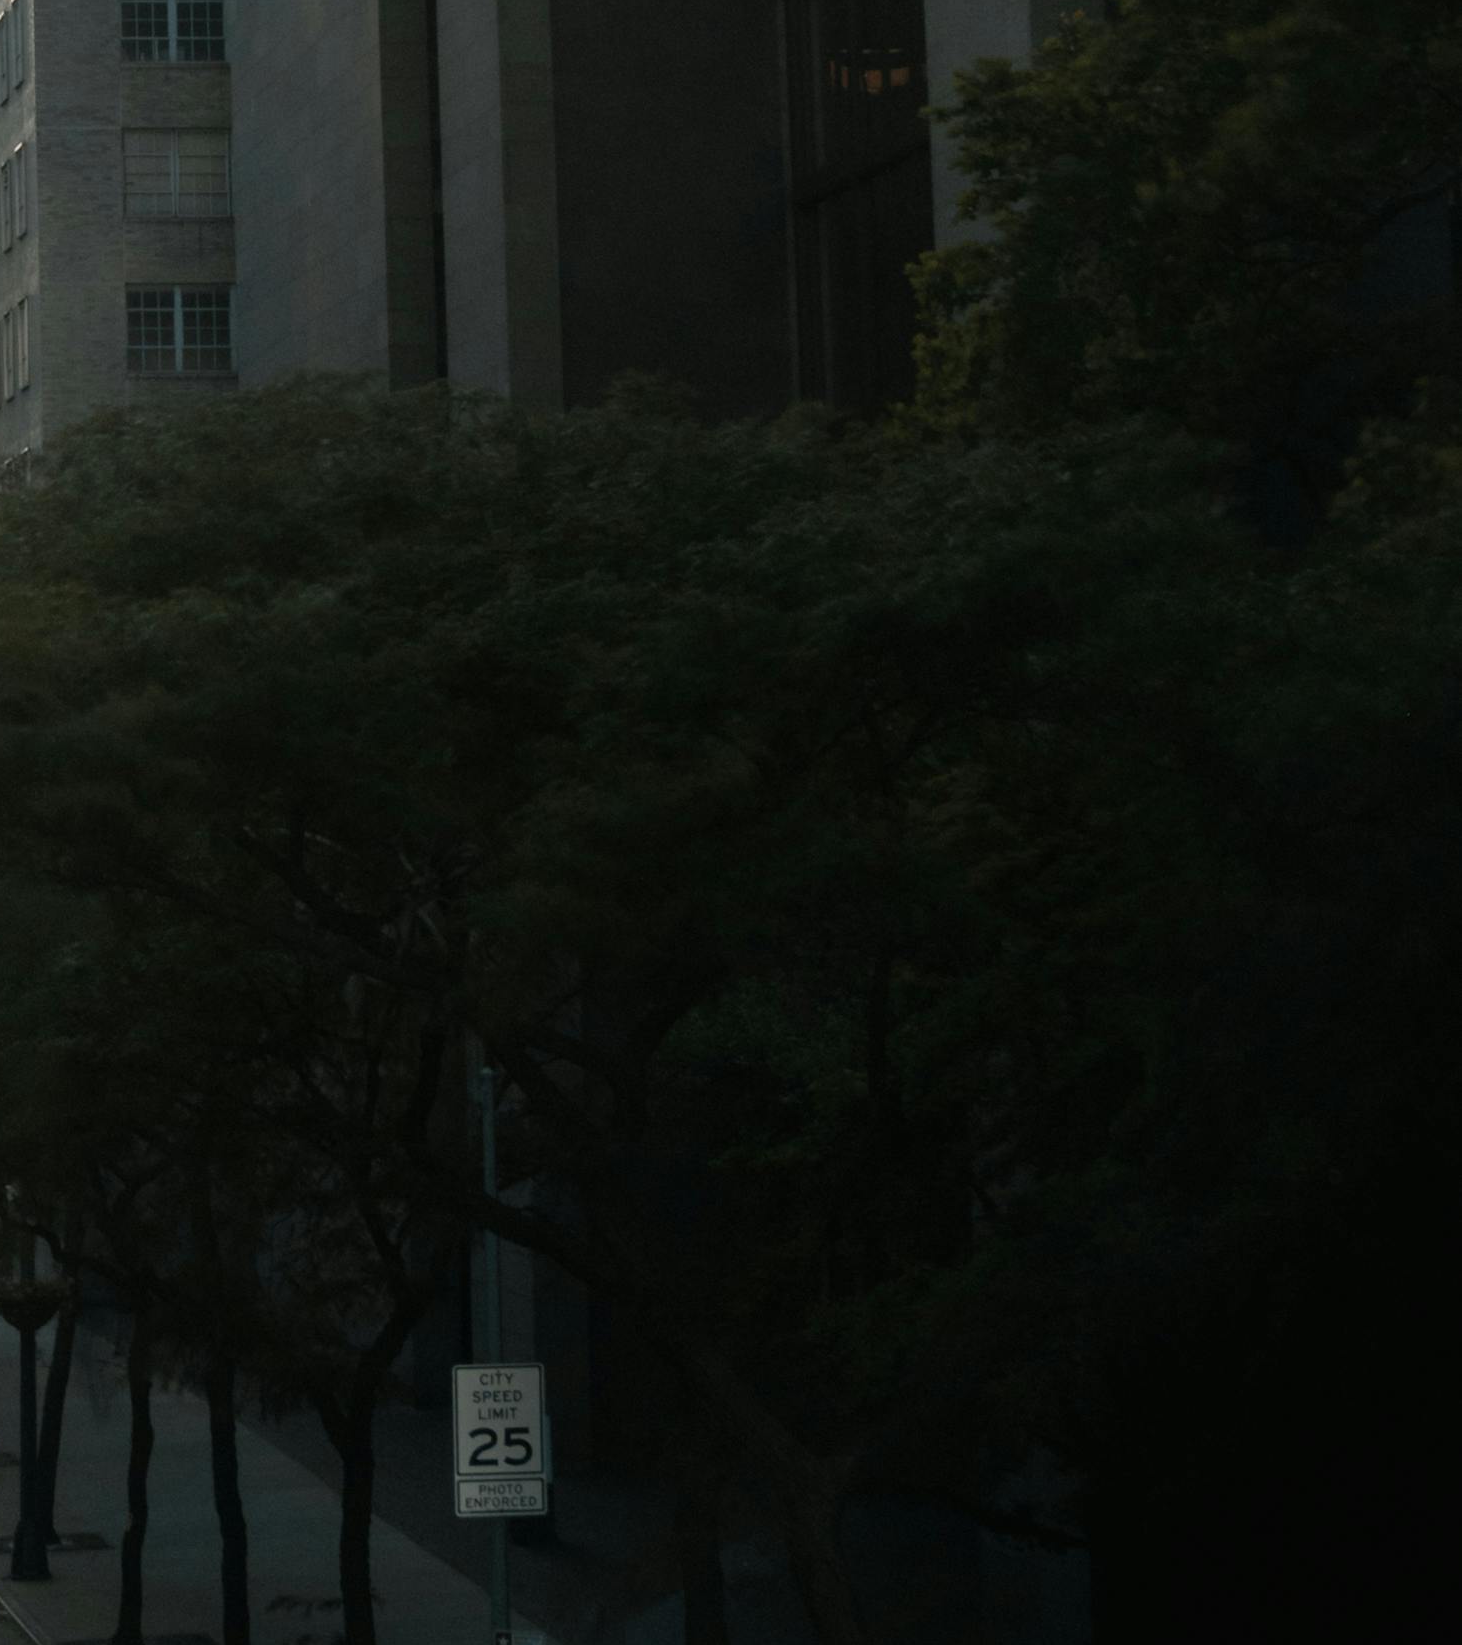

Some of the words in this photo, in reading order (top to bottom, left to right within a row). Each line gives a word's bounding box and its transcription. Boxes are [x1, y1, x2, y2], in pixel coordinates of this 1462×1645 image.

[479, 1373, 514, 1386] CITY
[473, 1390, 523, 1403] SPEED
[478, 1407, 517, 1420] LIMIT
[469, 1427, 532, 1466] 25
[479, 1483, 523, 1495] PHOTO
[465, 1495, 537, 1508] ENFORCED
